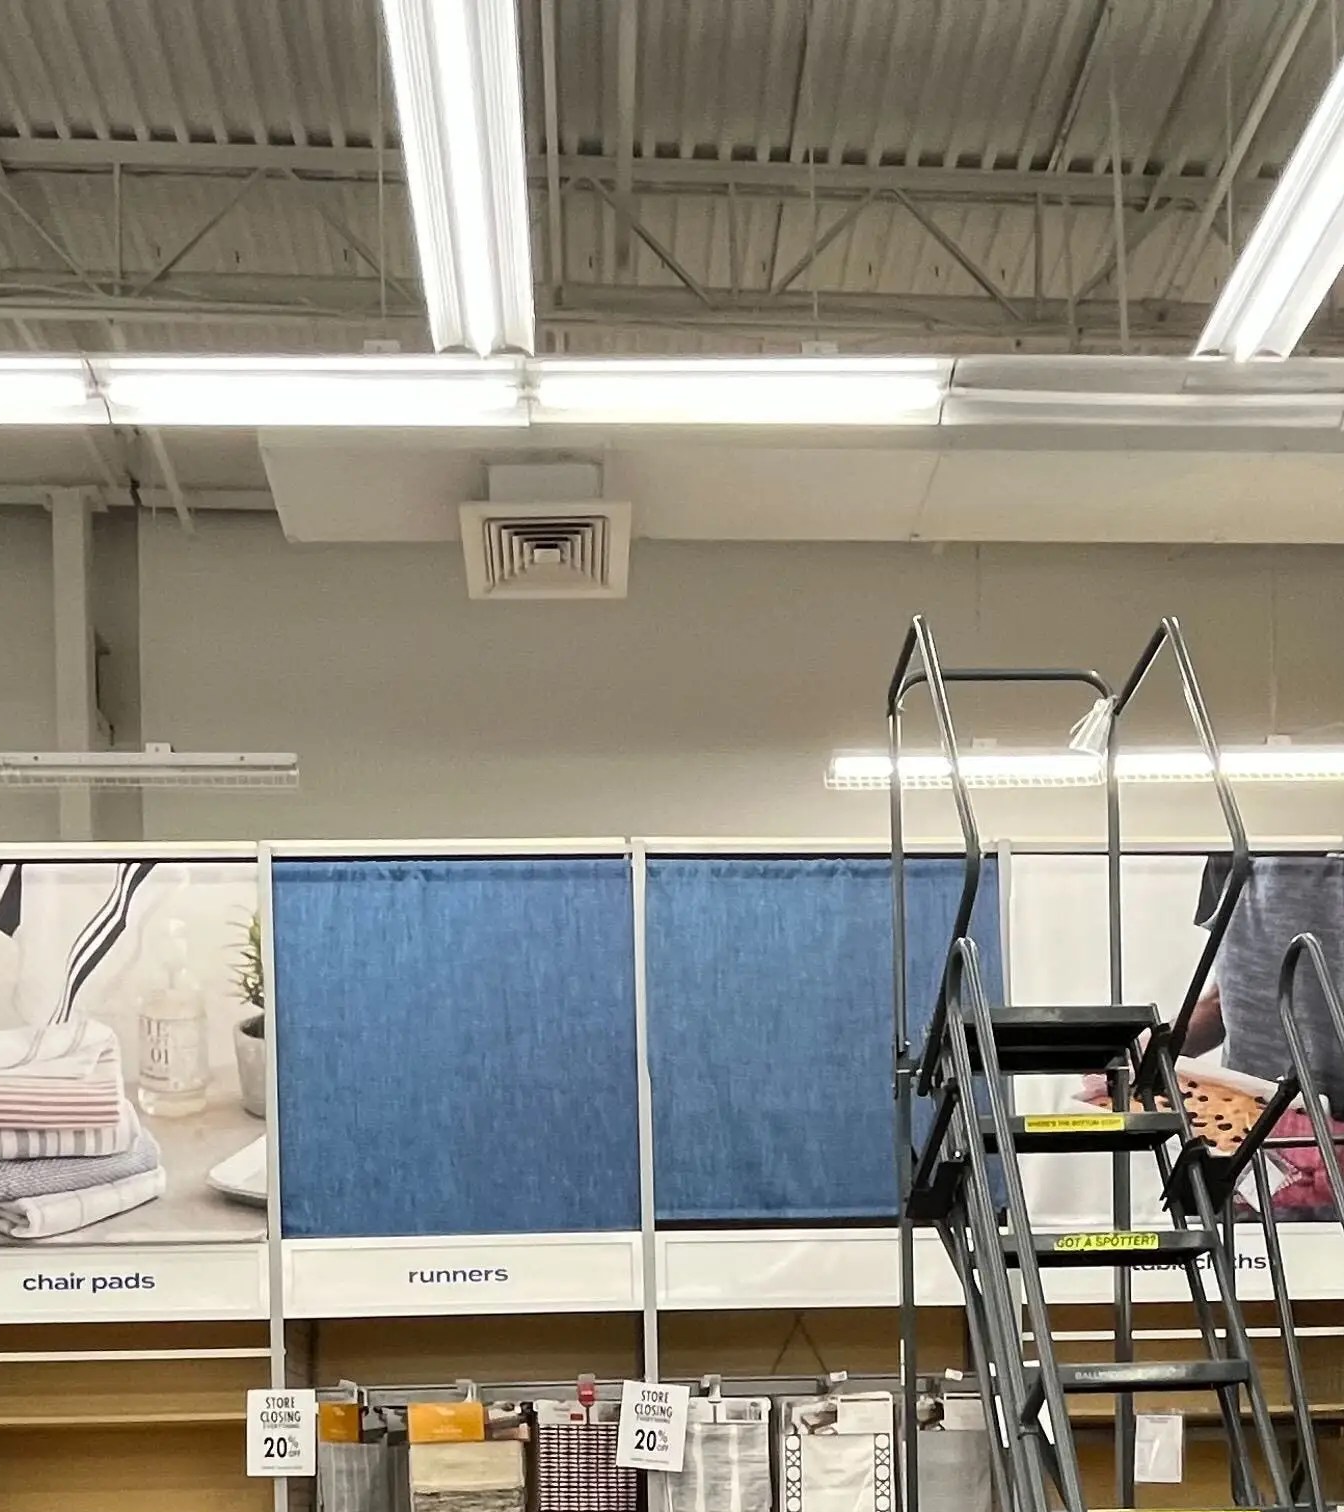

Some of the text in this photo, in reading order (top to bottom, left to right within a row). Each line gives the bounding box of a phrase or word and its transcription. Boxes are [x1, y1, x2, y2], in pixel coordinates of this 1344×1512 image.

[1057, 1235, 1156, 1248] GOT A SPOTTER?
[408, 1268, 509, 1283] runners
[22, 1272, 156, 1294] chair pads
[265, 1396, 295, 1409] STORE
[641, 1390, 669, 1404] STORE
[260, 1411, 301, 1423] CLOSING
[635, 1403, 673, 1418] CLOSING
